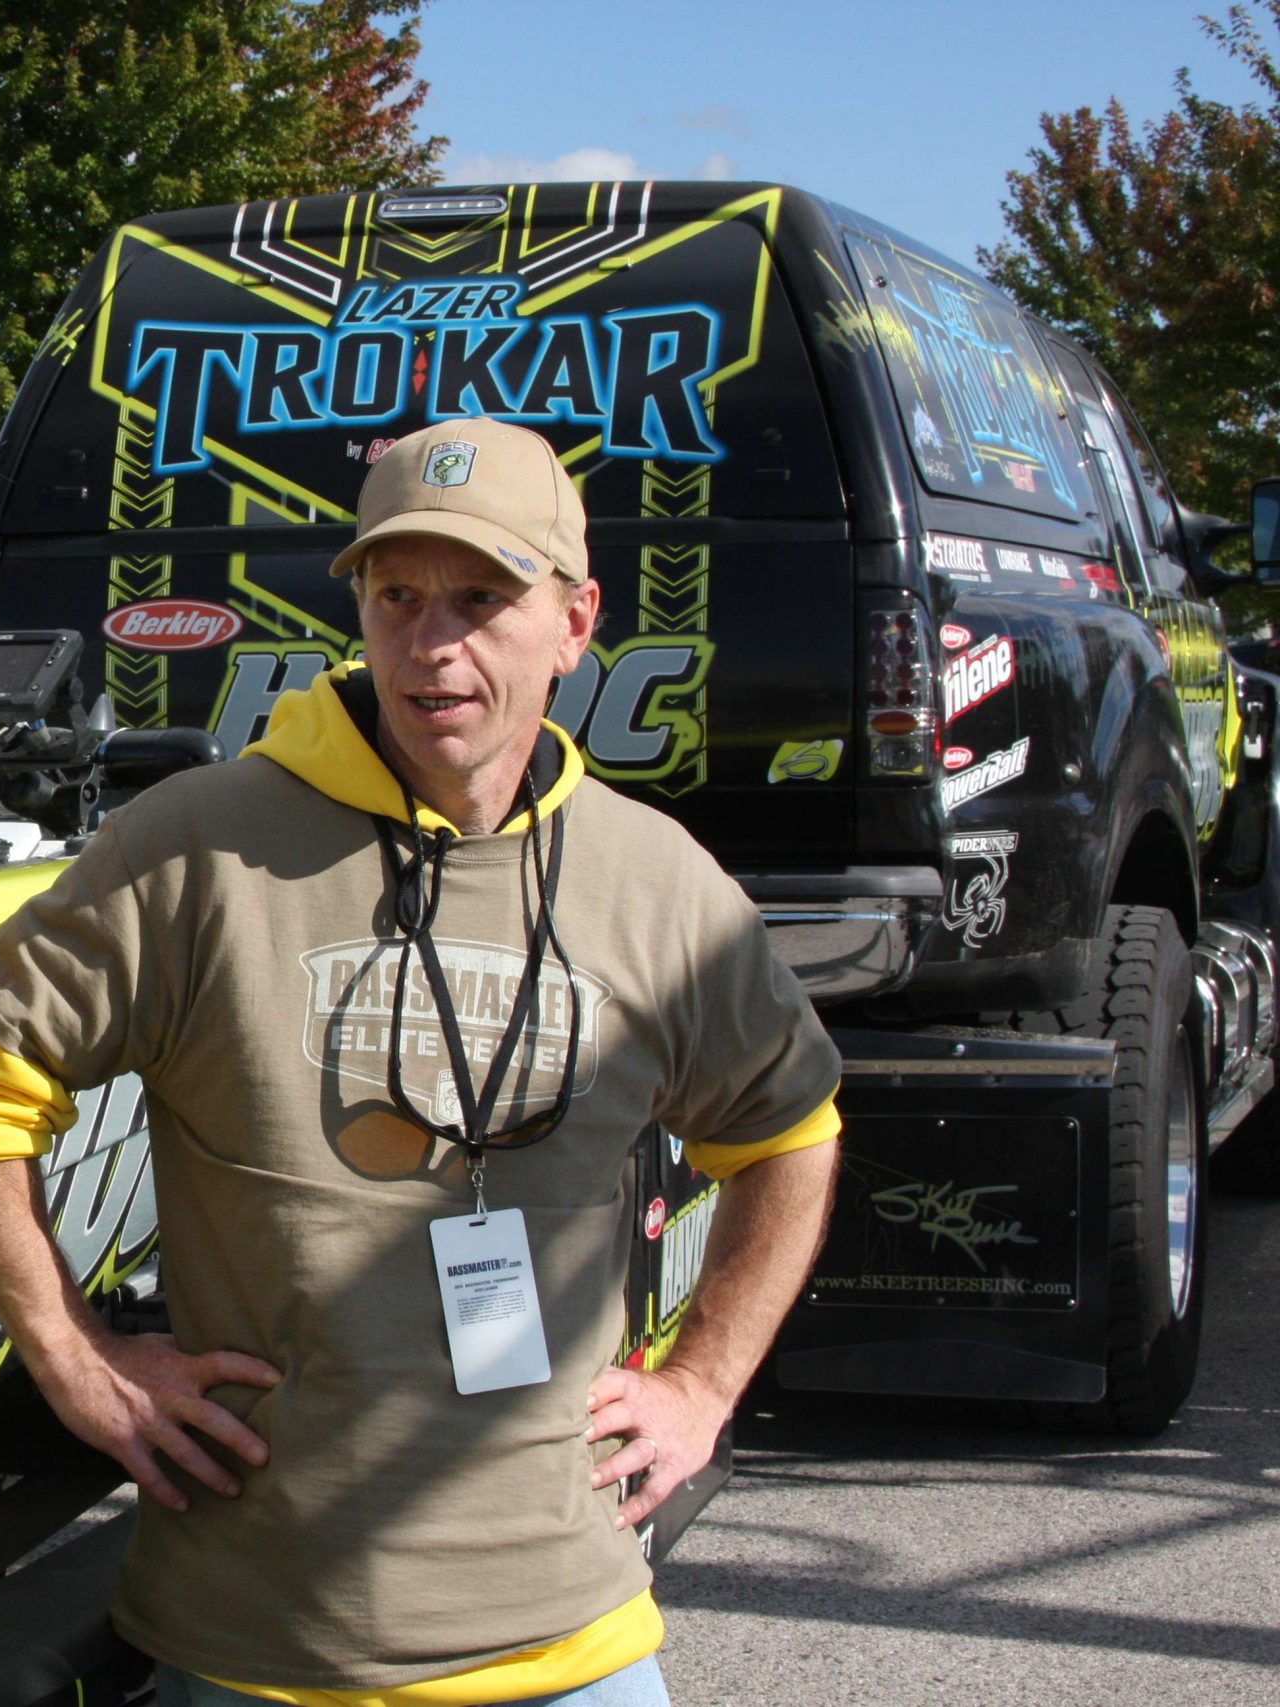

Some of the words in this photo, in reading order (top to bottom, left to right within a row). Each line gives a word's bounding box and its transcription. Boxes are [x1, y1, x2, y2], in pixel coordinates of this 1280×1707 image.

[342, 283, 518, 324] LAZER
[129, 309, 725, 470] TROKAR
[347, 440, 363, 460] by
[933, 536, 987, 572] STRATOS
[122, 609, 226, 643] Berkley
[951, 836, 1016, 854] PIDERWIRE
[331, 1025, 439, 1058] ELITE
[461, 1034, 573, 1075] SERIES
[447, 1259, 501, 1277] BASSMASTER
[813, 1273, 1072, 1296] www.SKEETREESEINC.com
